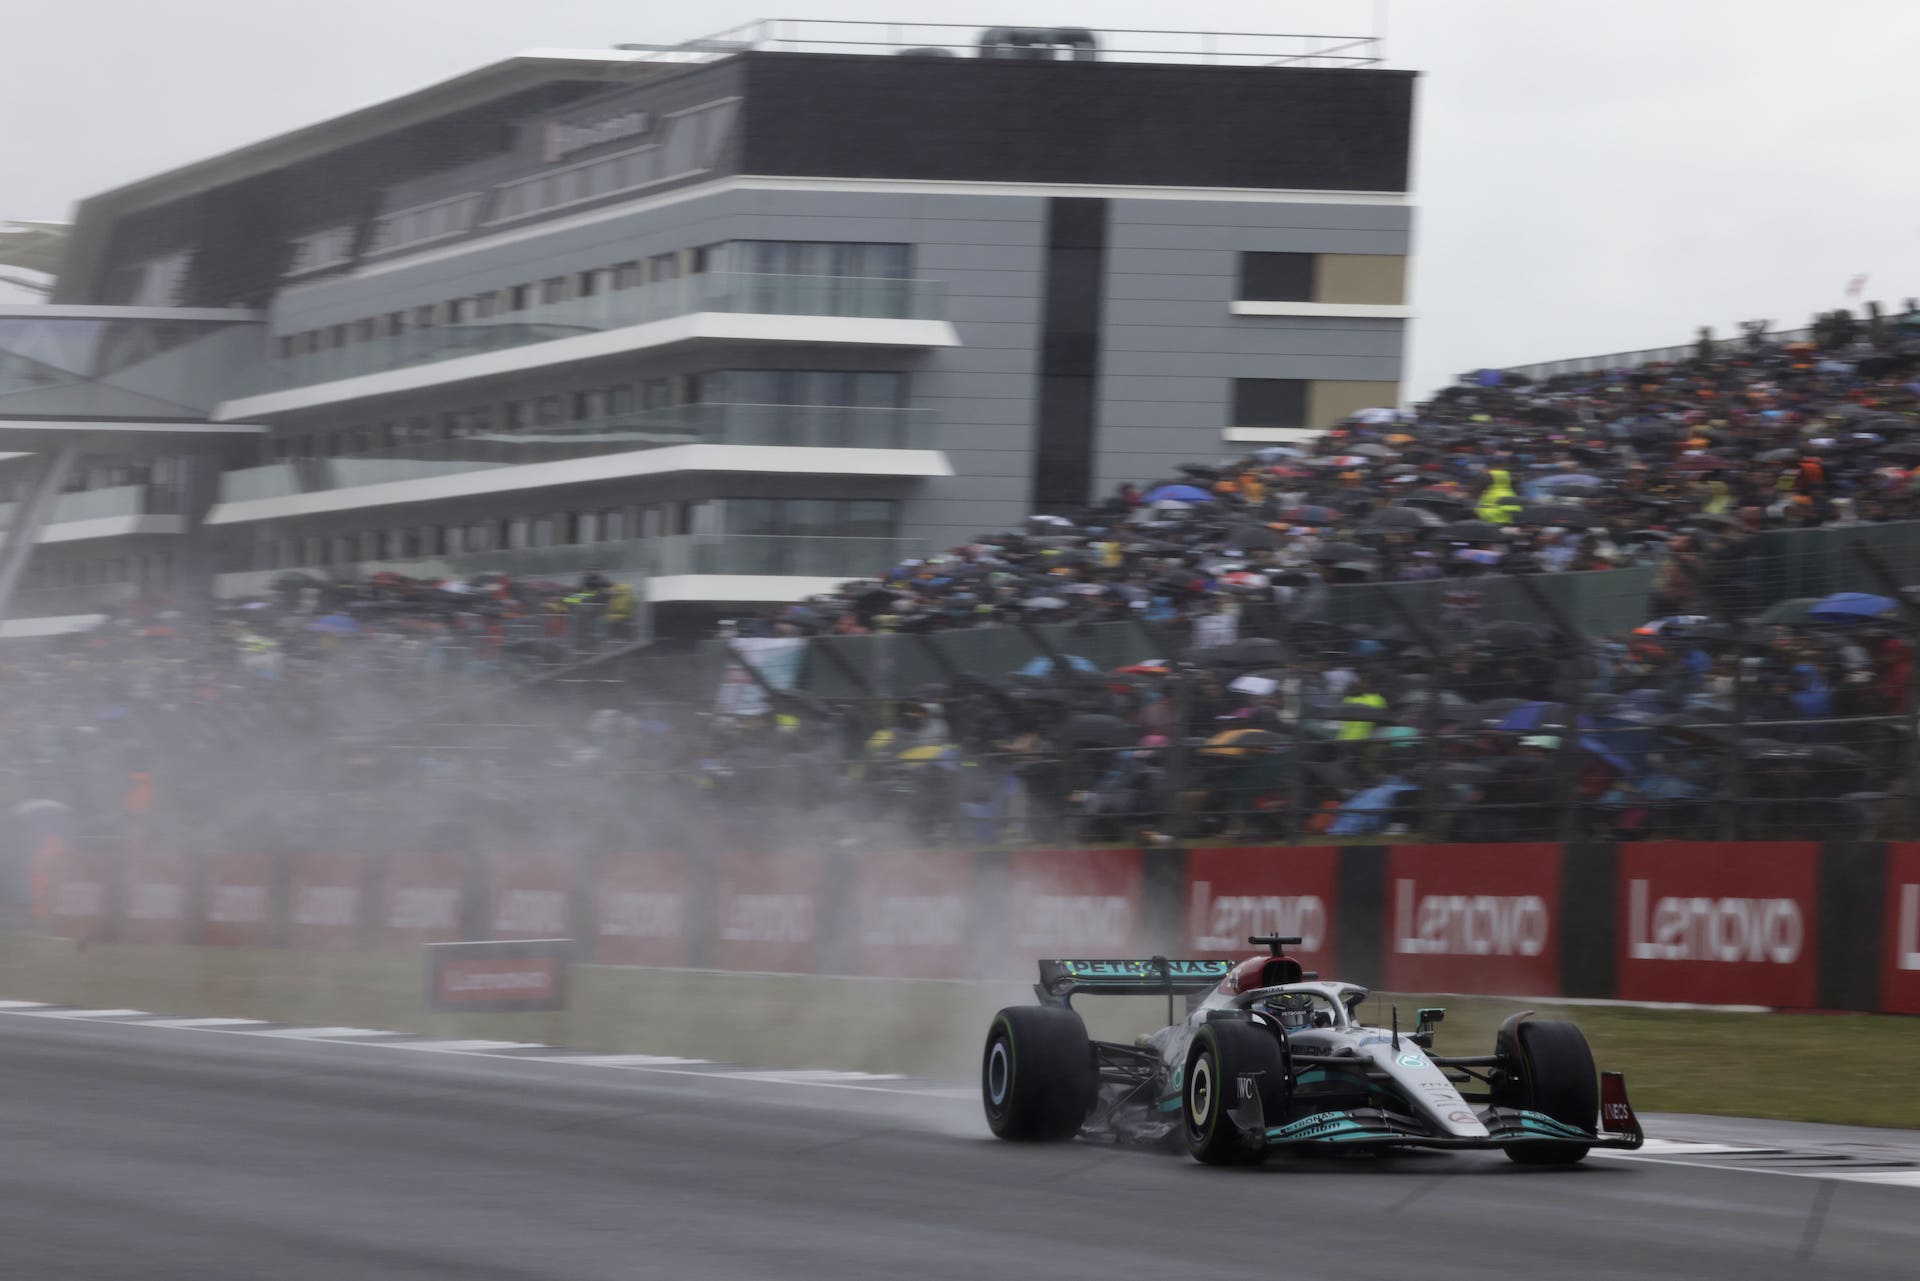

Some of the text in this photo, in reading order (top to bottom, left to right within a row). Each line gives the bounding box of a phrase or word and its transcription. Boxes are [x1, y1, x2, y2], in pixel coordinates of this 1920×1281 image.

[1191, 880, 1326, 953] Lenovo
[1395, 878, 1549, 956] Lenovo
[1629, 879, 1803, 963] Lenovo
[1236, 1077, 1253, 1100] IWC
[1605, 1103, 1629, 1120] INEOS
